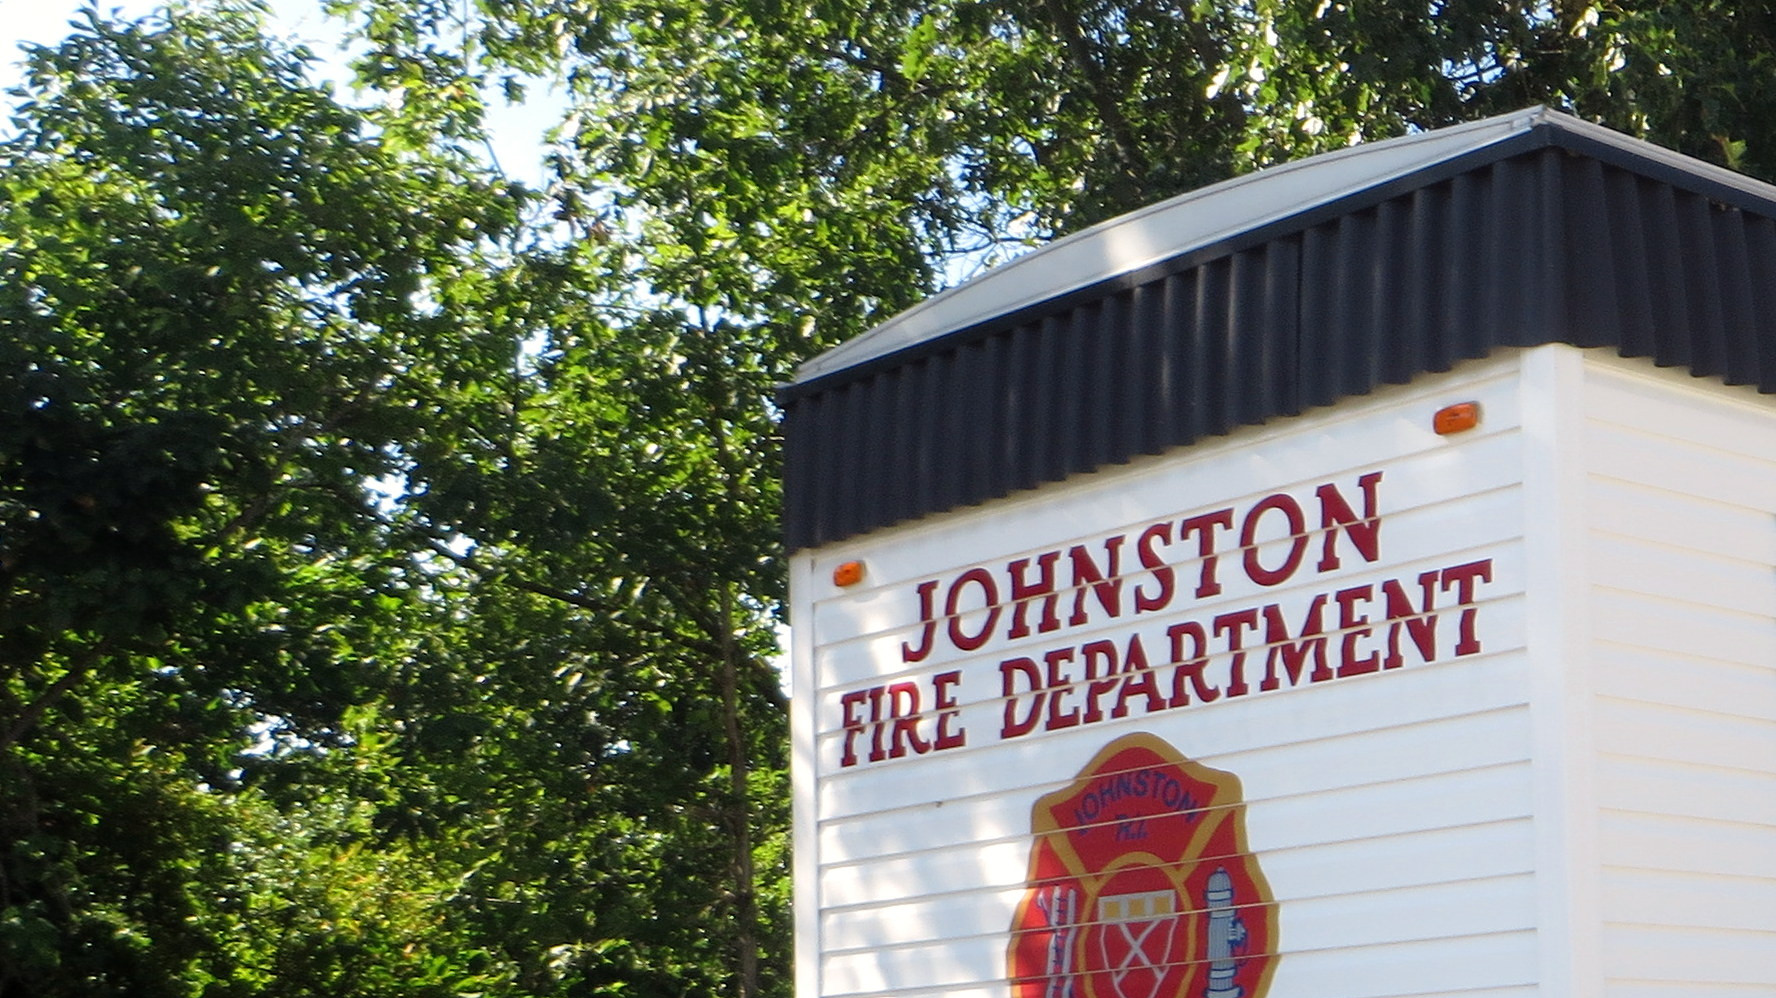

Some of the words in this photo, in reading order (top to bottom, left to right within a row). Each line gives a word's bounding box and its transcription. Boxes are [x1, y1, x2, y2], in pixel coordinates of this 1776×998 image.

[902, 471, 1383, 662] JOHNSTON
[840, 670, 965, 767] FIRE
[1000, 558, 1493, 740] DEPARTMENT
[1074, 769, 1198, 836] JOHNSTON
